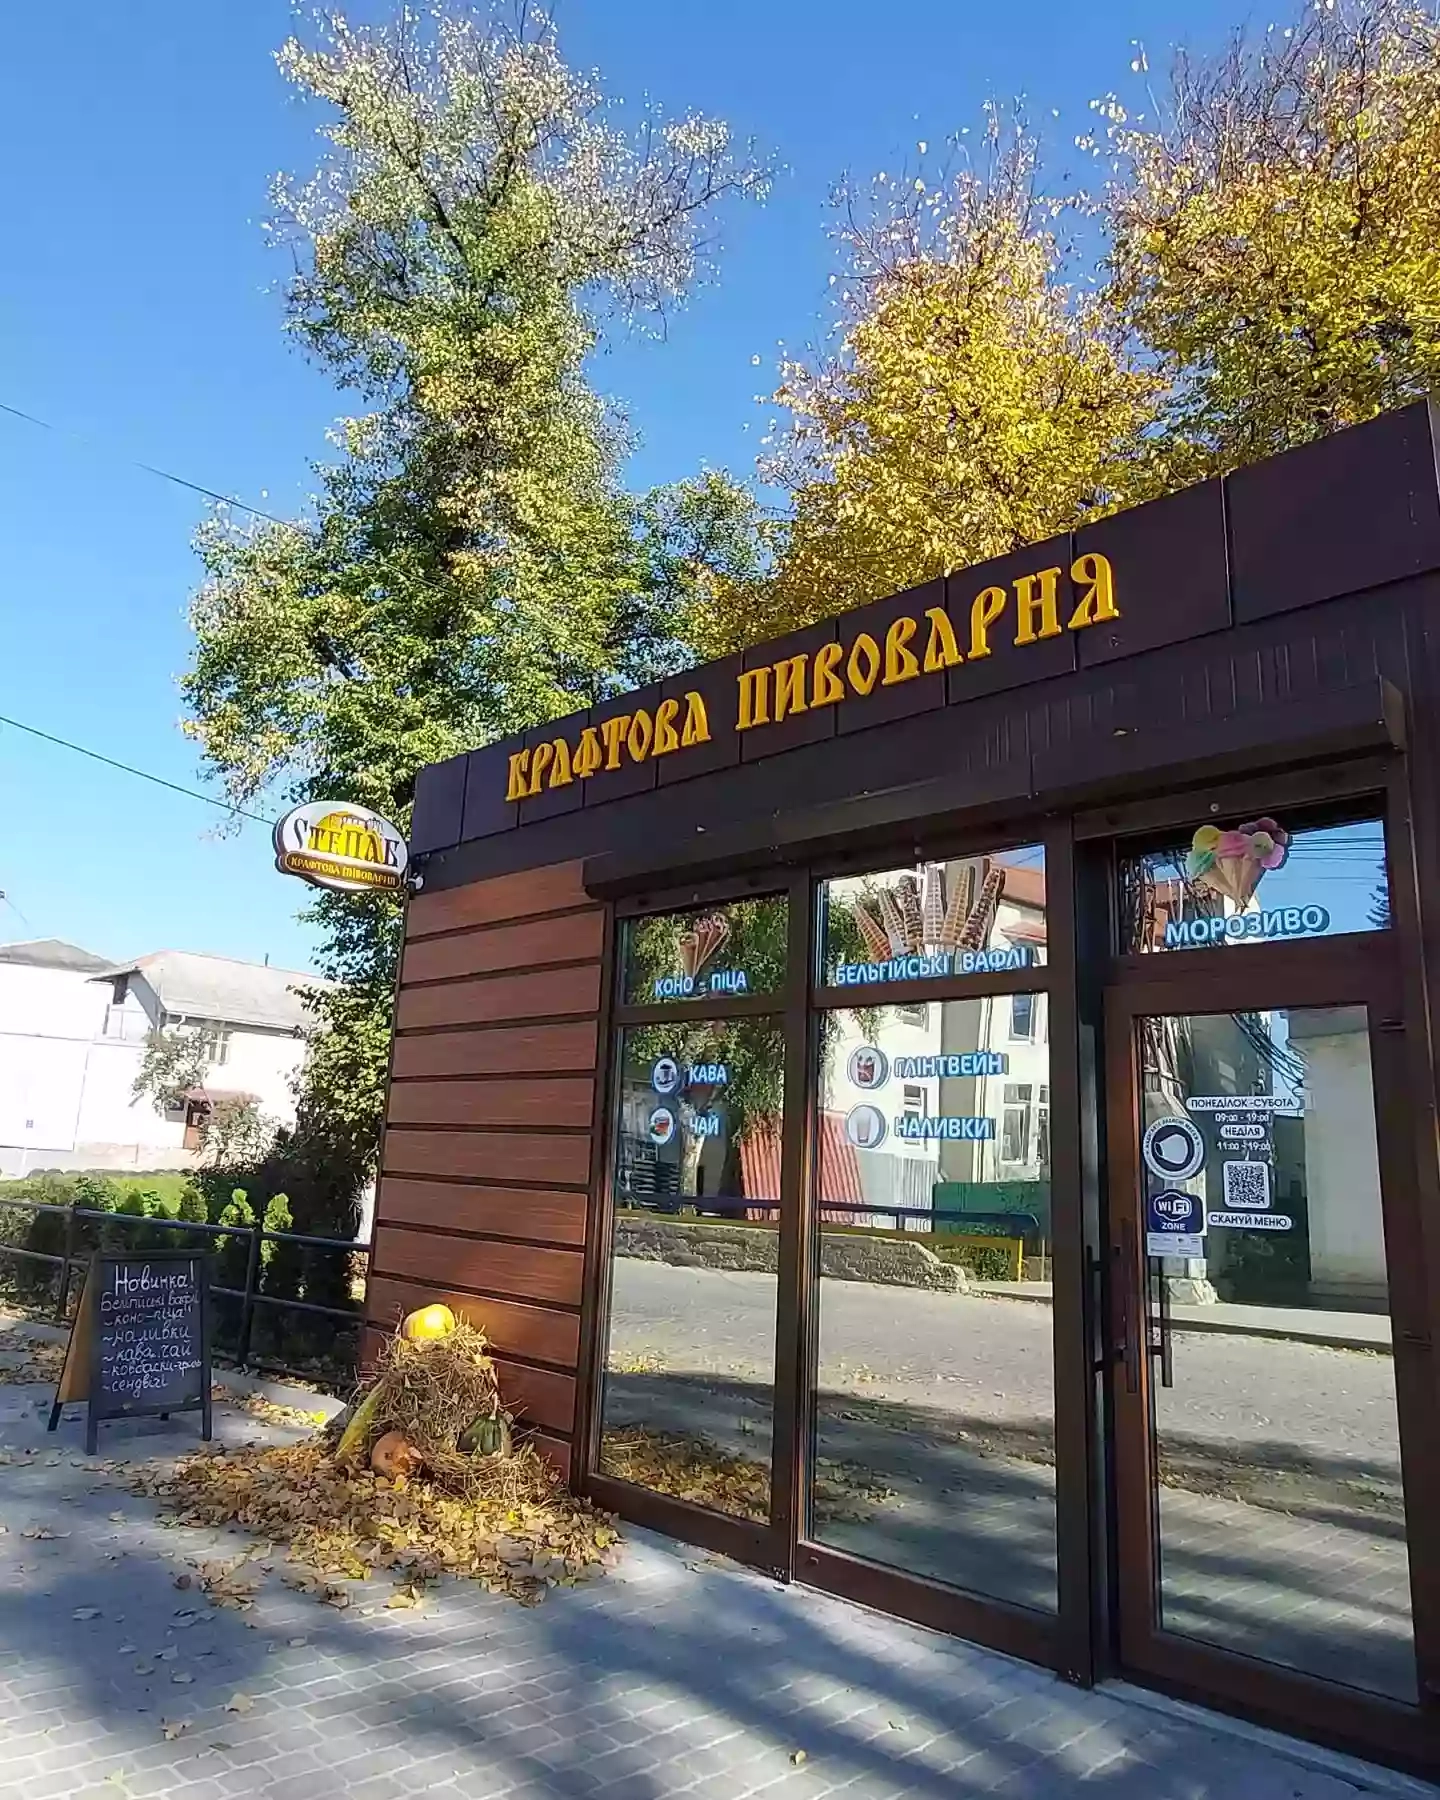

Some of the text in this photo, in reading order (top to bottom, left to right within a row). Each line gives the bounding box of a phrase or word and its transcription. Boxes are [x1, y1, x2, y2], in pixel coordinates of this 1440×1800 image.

[505, 553, 1120, 802] КРАФТОВА ПИВОВАРНЯ
[1166, 905, 1325, 945] МОРОЗИВО
[835, 946, 1029, 984] БЕЛЬГІЙСЬКІ ВАФЛІ
[655, 976, 694, 996] КОНО
[711, 970, 748, 991] ПІЦА
[688, 1064, 728, 1084] КАВА
[894, 1051, 1004, 1077] ГЛІНТВЕЙН
[689, 1114, 719, 1135] ЧАЙ
[1247, 1112, 1270, 1122] 19:00
[895, 1117, 991, 1140] НАЛИВКИ
[1225, 1126, 1260, 1136] НЕДІЛЯ
[1217, 1141, 1239, 1151] 11:00
[1249, 1141, 1271, 1151] 19:00
[1161, 1222, 1186, 1231] ZONE
[1210, 1214, 1287, 1228] СКАНУЙ МЕНЮ
[115, 1260, 194, 1297] Новинка!
